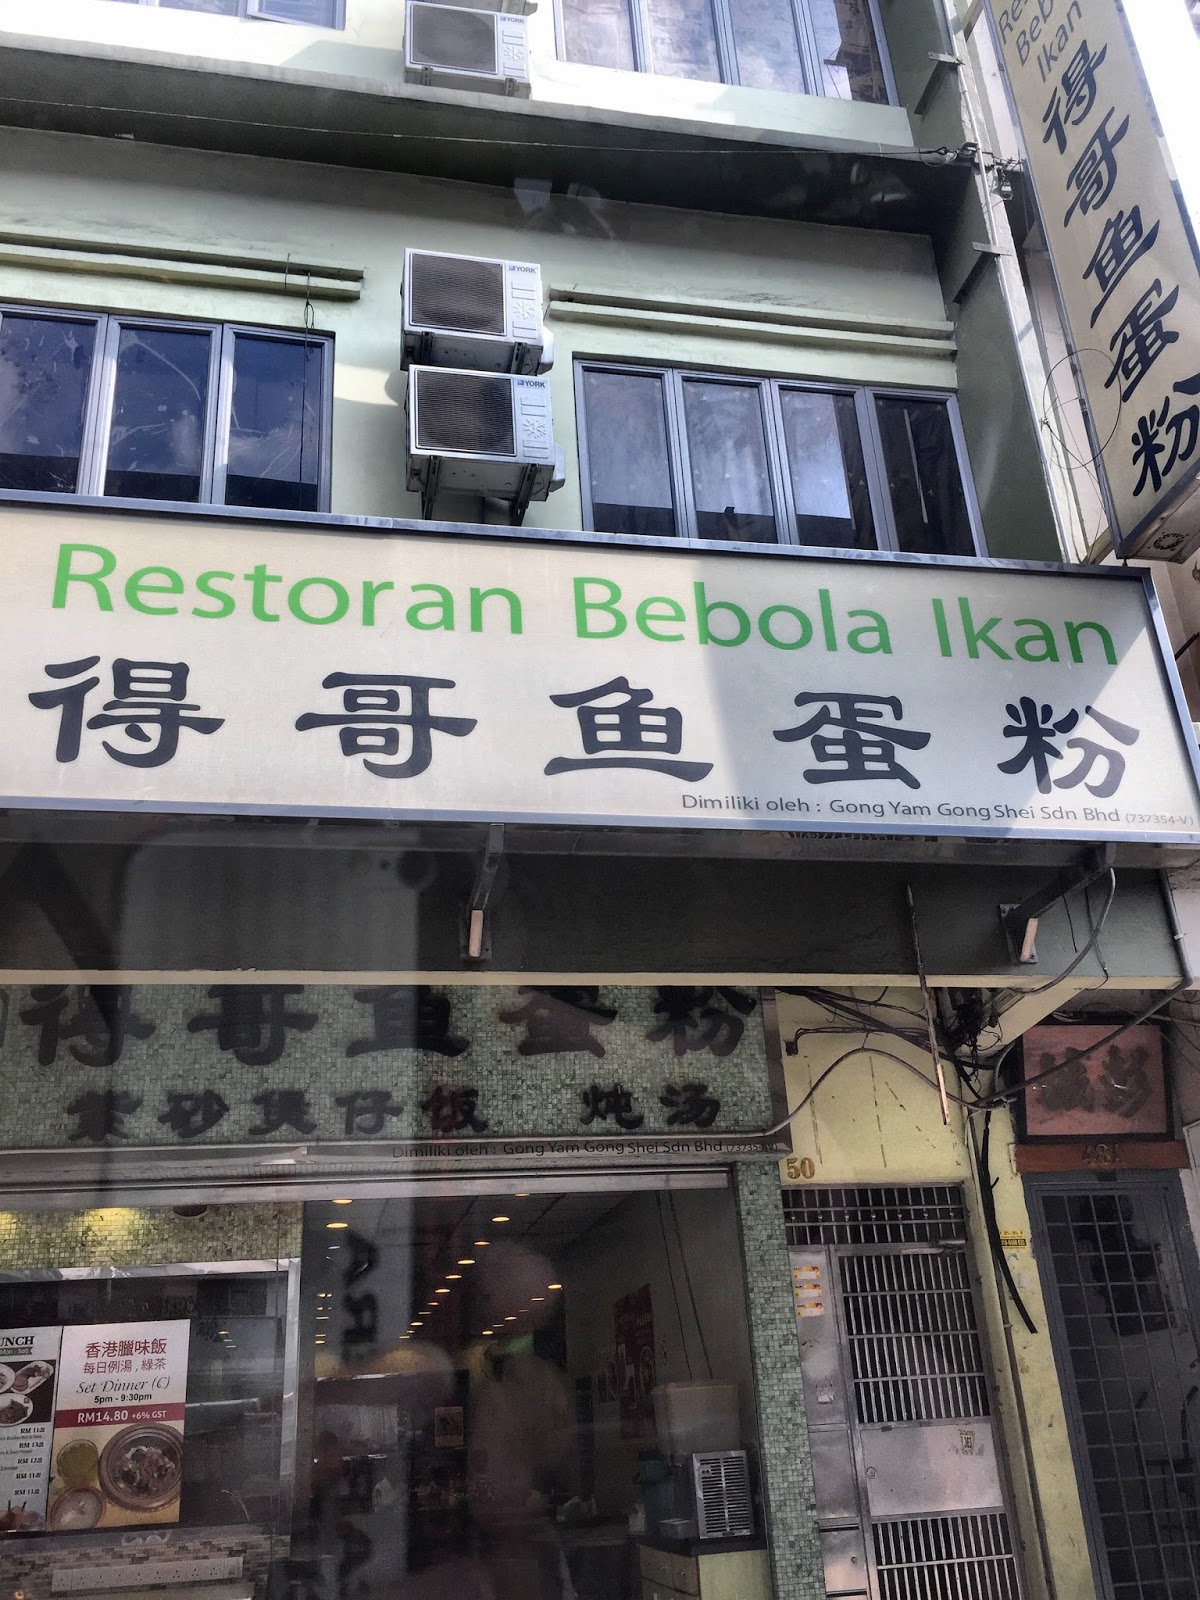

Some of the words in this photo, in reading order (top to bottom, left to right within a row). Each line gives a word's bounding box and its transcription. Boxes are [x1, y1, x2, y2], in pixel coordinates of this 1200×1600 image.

[506, 16, 525, 24] YORK
[1037, 0, 1082, 83] Ikan
[516, 265, 536, 274] YORK
[1043, 39, 1200, 496] 得哥鱼蛋粉
[524, 380, 545, 388] YORK
[51, 543, 523, 635] Restoran
[572, 576, 893, 655] Bebola
[932, 597, 1117, 666] Ikan
[28, 655, 1140, 798] 得哥鱼蛋粉
[682, 794, 759, 811] Dimiliki
[766, 798, 810, 812] oleh
[830, 800, 884, 817] Gong
[889, 801, 931, 815] Yam
[937, 803, 991, 821] Gong
[995, 804, 1035, 819] Shei
[1041, 806, 1077, 820] Sdn
[1083, 808, 1120, 822] Bhd
[1125, 813, 1194, 826] (737354-V)
[392, 1144, 450, 1158] Dimiliki
[456, 1145, 489, 1156] oleh
[503, 1143, 544, 1157] Gong
[549, 1142, 580, 1153] Yam
[584, 1141, 624, 1155] Gong
[628, 1142, 658, 1154] Shei
[659, 1141, 690, 1153] Sdn
[694, 1140, 723, 1152] Bhd
[786, 1157, 816, 1180] 50
[76, 1380, 97, 1394] Set
[101, 1379, 148, 1393] Dinner
[151, 1376, 171, 1391] (C)
[94, 1395, 113, 1405] 5pm
[120, 1393, 152, 1403] 9:30pm
[77, 1410, 129, 1424] RM14.80
[152, 1410, 167, 1419] GST
